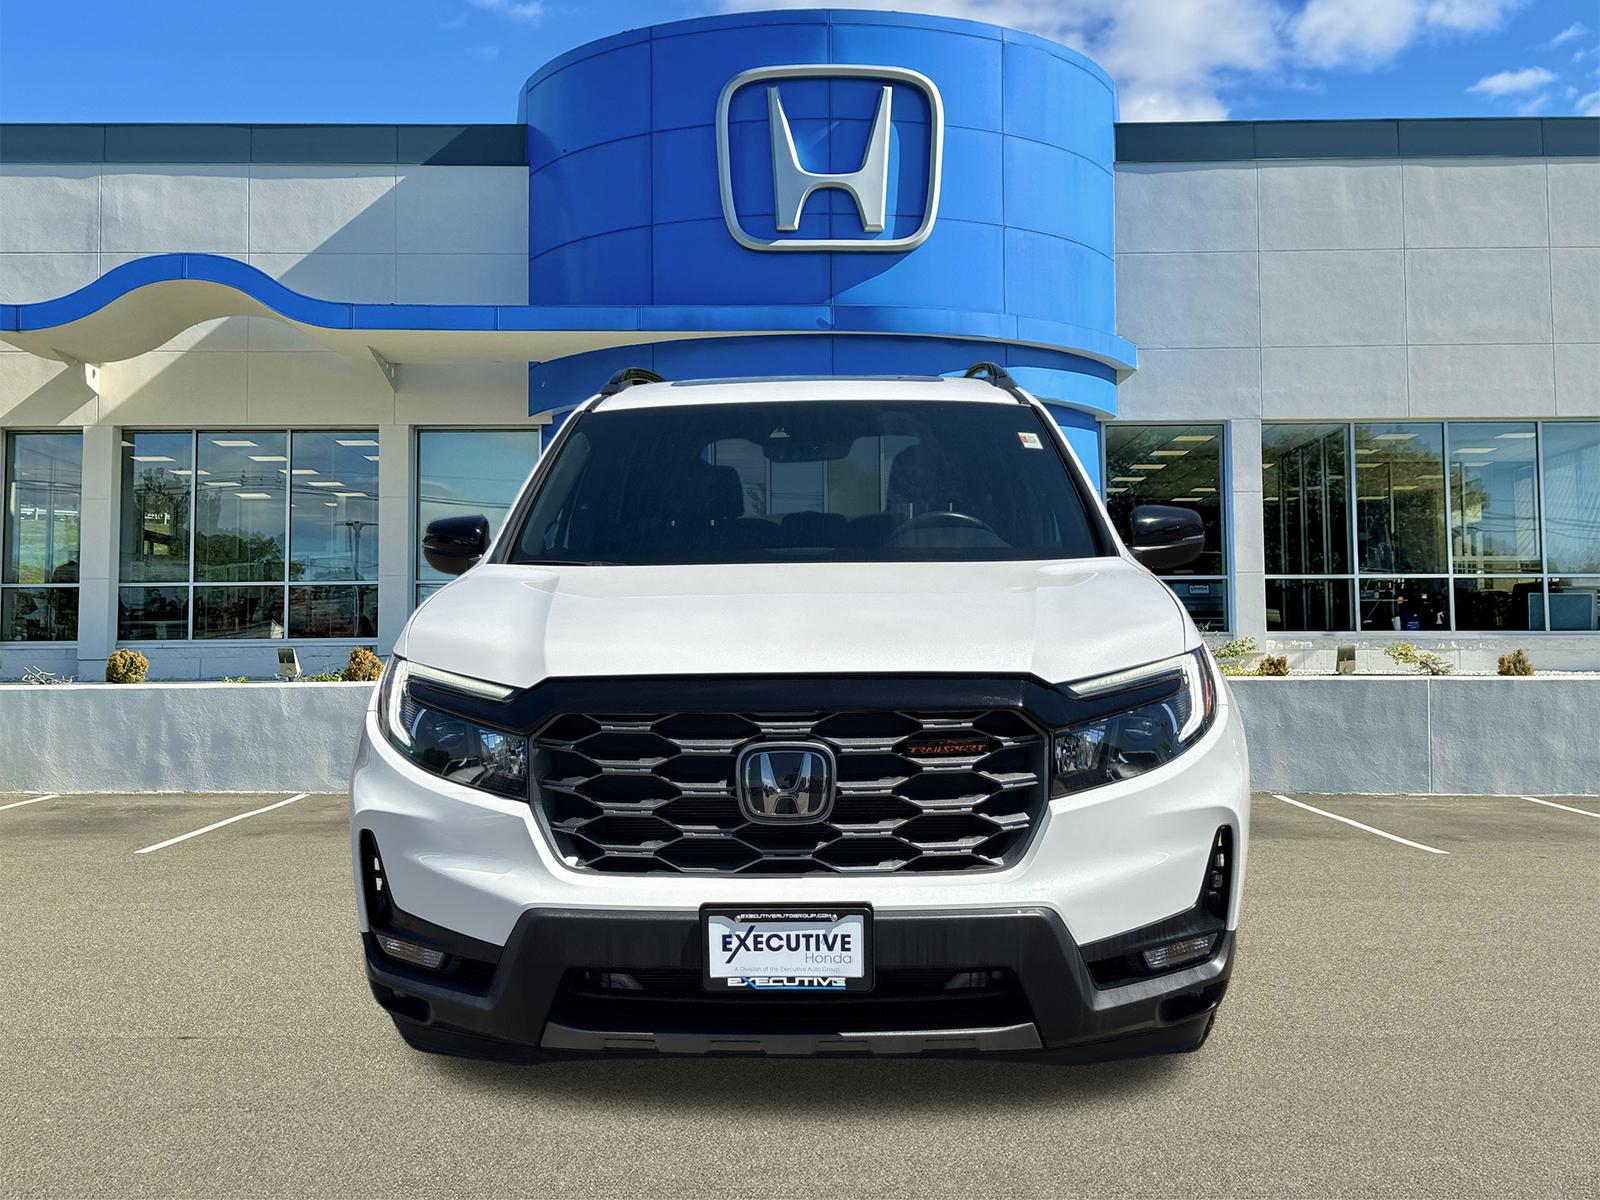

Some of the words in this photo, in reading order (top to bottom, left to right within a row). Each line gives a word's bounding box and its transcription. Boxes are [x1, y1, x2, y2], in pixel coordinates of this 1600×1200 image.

[907, 744, 986, 753] TRAILSPORT
[721, 925, 852, 964] EXECUTIVE
[805, 952, 852, 964] Honda
[822, 966, 840, 974] Group
[727, 977, 847, 987] EXECUTIVE
